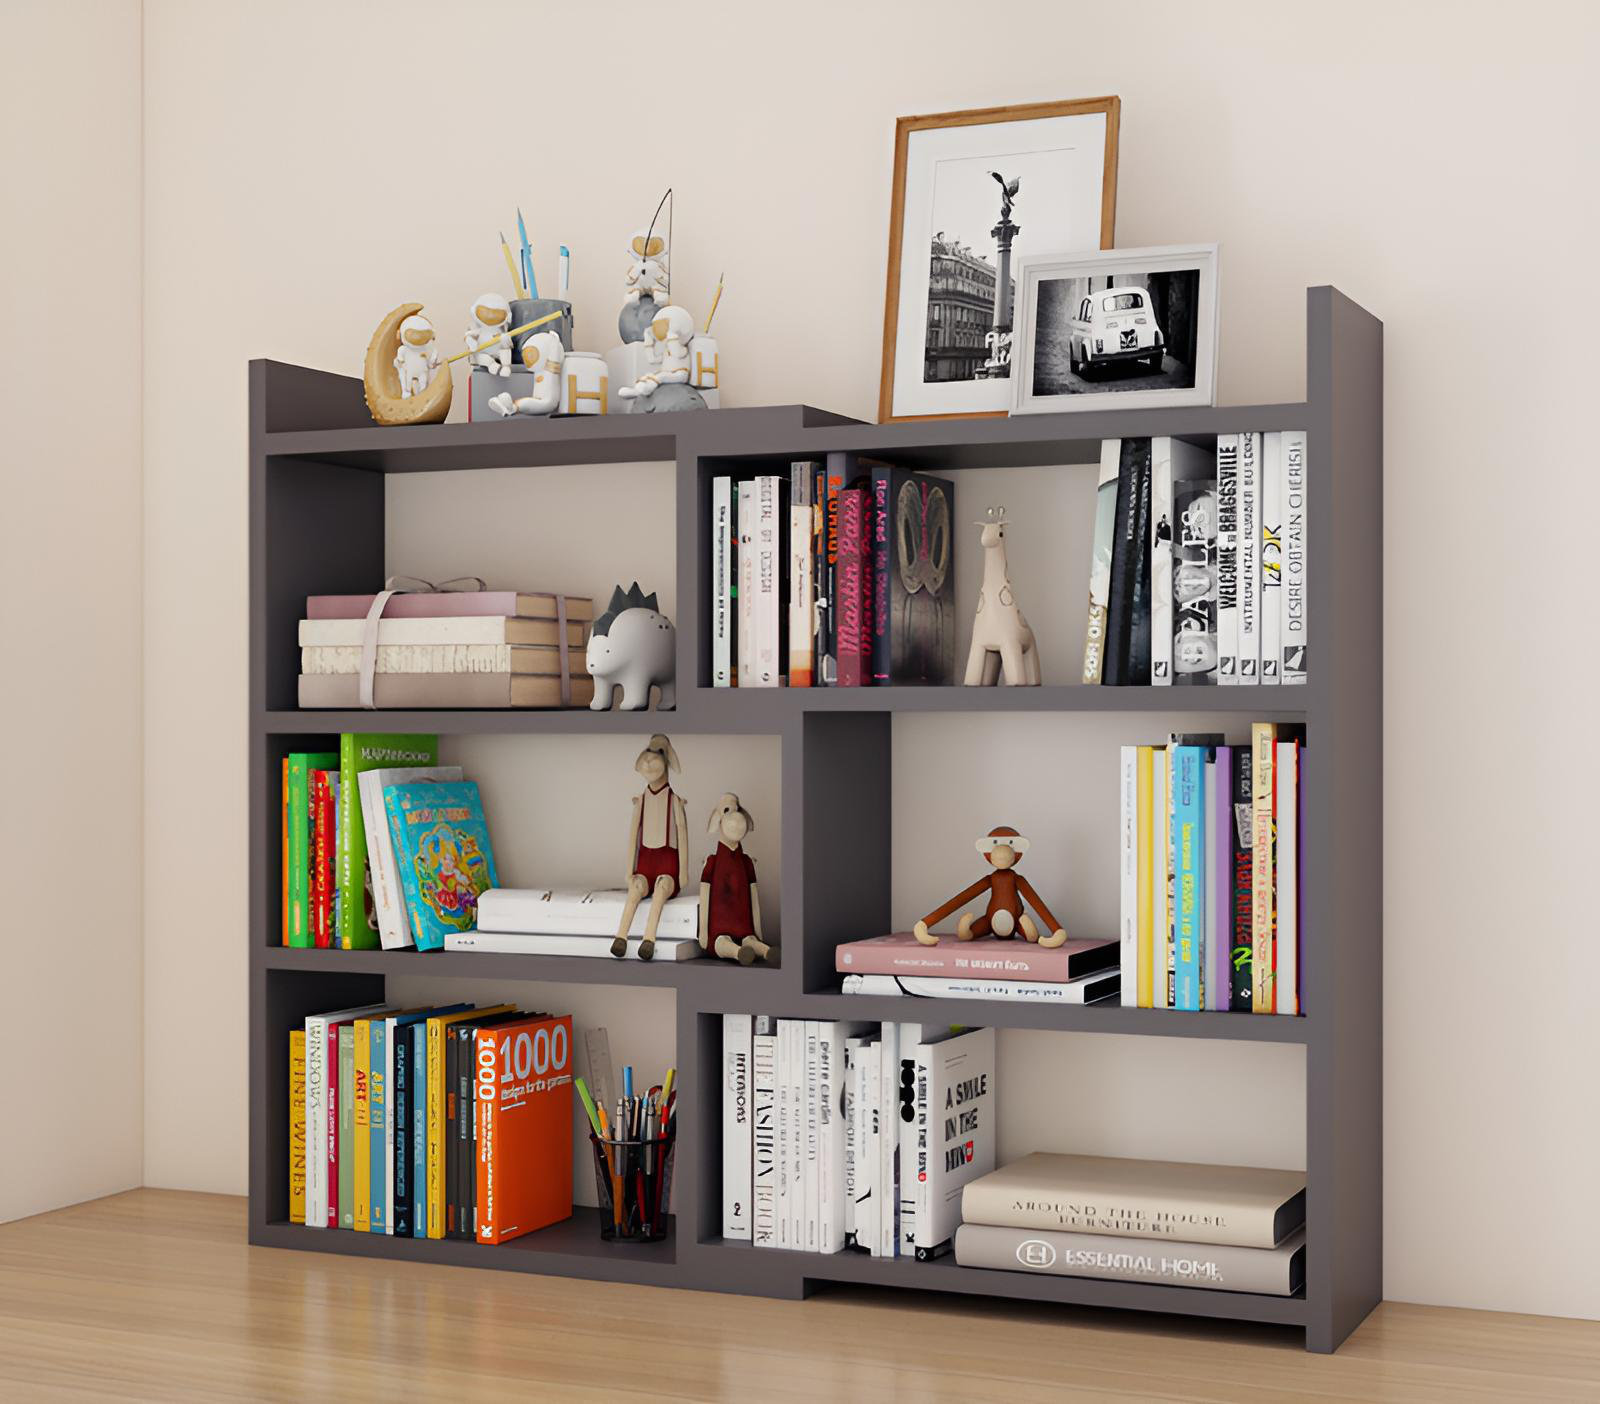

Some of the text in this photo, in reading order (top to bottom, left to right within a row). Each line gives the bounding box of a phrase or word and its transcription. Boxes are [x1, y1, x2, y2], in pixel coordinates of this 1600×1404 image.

[1288, 514, 1303, 574] OBTAIN
[1219, 546, 1237, 610] WELCOME
[838, 563, 859, 656] Martin
[1288, 579, 1303, 631] DESIRE
[478, 1037, 496, 1100] 1000
[500, 1024, 568, 1083] 1000
[820, 1041, 830, 1080] pierre
[356, 1070, 367, 1102] ART
[371, 1071, 384, 1105] ART
[945, 1087, 954, 1110] A
[956, 1074, 987, 1106] SMILE
[756, 1088, 775, 1178] FASHION
[945, 1108, 978, 1142] IN THE
[1012, 1201, 1227, 1227] AROUND THE HOUSE
[1065, 1249, 1220, 1279] ESSENTIAL HOME
